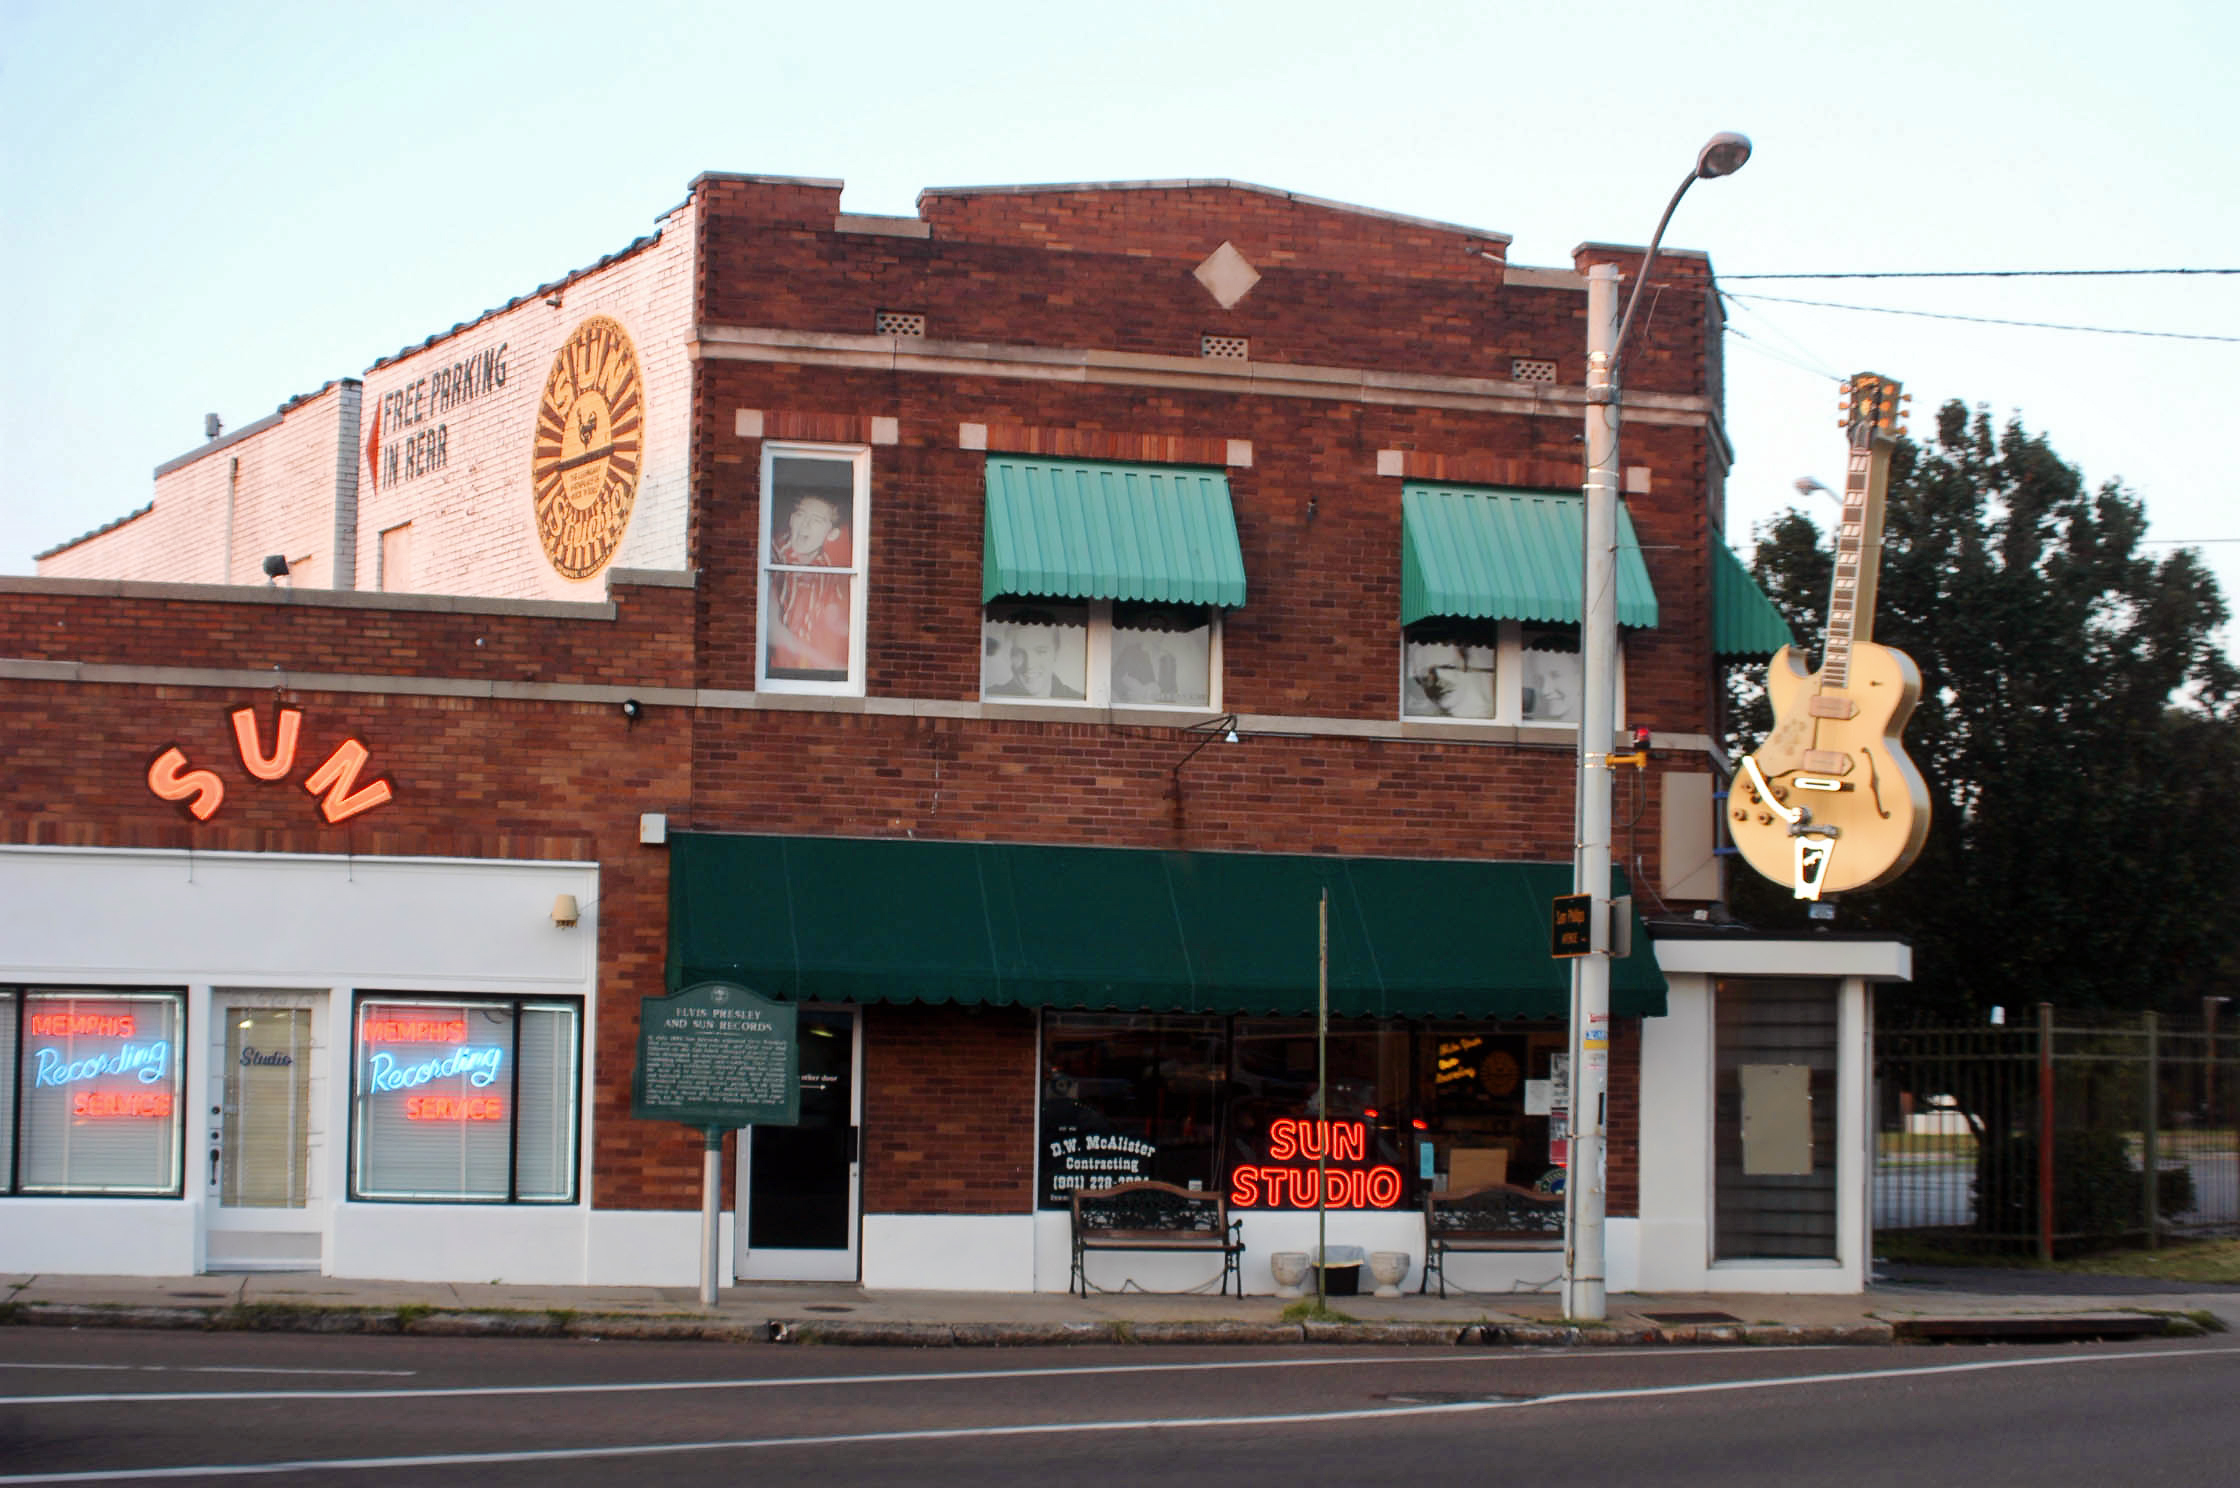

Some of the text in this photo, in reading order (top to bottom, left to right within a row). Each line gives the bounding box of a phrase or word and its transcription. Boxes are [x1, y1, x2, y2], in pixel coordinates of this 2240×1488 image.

[383, 342, 508, 436] FREE PARKING
[553, 338, 633, 418] SUN
[383, 423, 448, 489] IN REAR
[546, 481, 625, 548] Studio
[148, 707, 393, 824] SUN
[32, 1014, 136, 1037] MEMPHIS
[664, 1019, 773, 1032] AND SUN RECORDS
[675, 1007, 761, 1021] ELVIS PRESLEY
[364, 1019, 466, 1042] MEMPHIS
[35, 1040, 169, 1089] Recording
[240, 1046, 293, 1066] Studio
[369, 1047, 503, 1094] Recording
[73, 1093, 173, 1117] SERVICE
[406, 1096, 503, 1121] SERVICE
[1050, 1135, 1156, 1157] D.W. McAlister
[1269, 1118, 1365, 1161] SUN
[1066, 1157, 1139, 1173] Contracting
[1053, 1175, 1085, 1190] (901)
[1230, 1164, 1402, 1209] STUDIO
